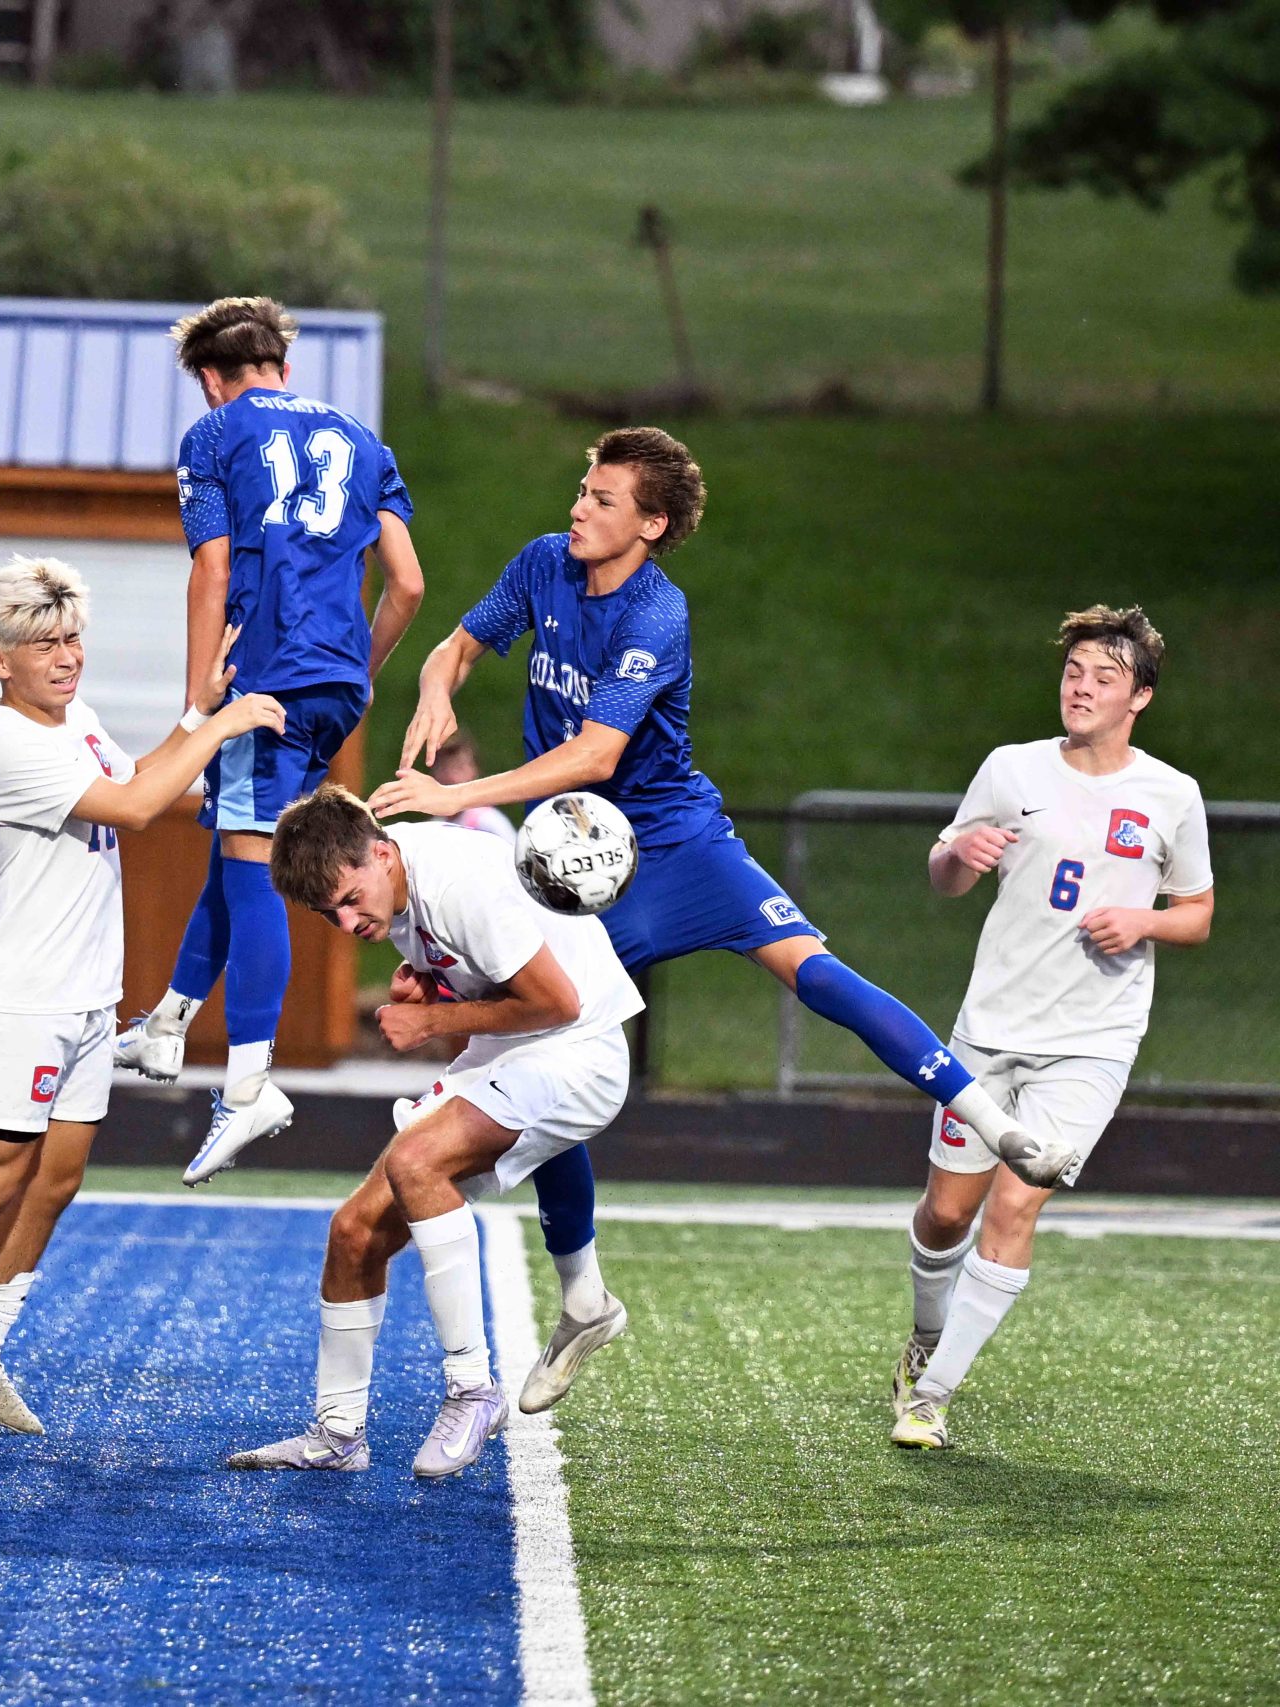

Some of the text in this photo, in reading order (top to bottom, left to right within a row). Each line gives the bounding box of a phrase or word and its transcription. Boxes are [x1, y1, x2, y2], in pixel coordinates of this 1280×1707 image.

[259, 427, 356, 539] 13
[530, 651, 591, 706] COLON
[1105, 808, 1150, 859] C
[561, 847, 624, 876] SELECT
[1049, 858, 1085, 912] 6
[31, 1065, 60, 1103] C
